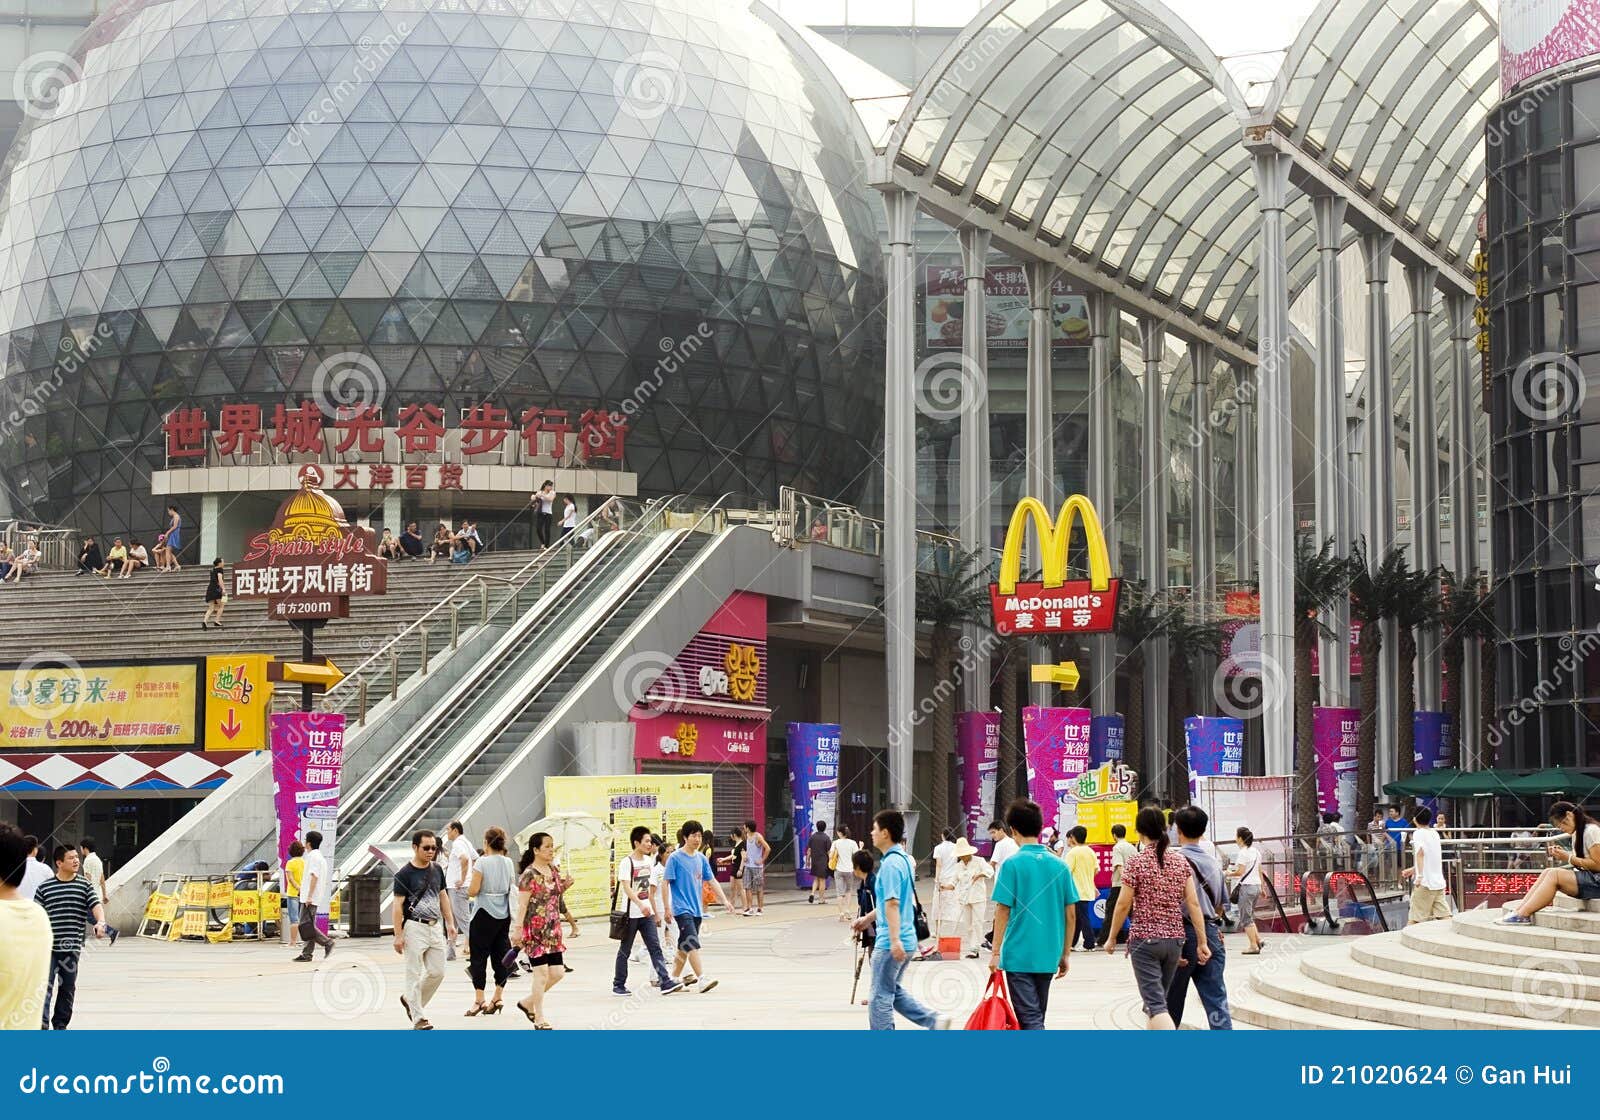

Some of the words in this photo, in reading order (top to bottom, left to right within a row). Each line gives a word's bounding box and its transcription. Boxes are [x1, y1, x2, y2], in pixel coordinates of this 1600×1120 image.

[163, 402, 629, 461] 世界城光谷步行街
[334, 463, 465, 490] 大洋百货
[244, 533, 313, 564] Spain
[317, 535, 365, 558] style
[235, 563, 373, 597] 西班牙风情街
[276, 600, 332, 616] 前方200m
[1005, 595, 1102, 612] McDonald's
[1015, 609, 1092, 628] 麦当劳
